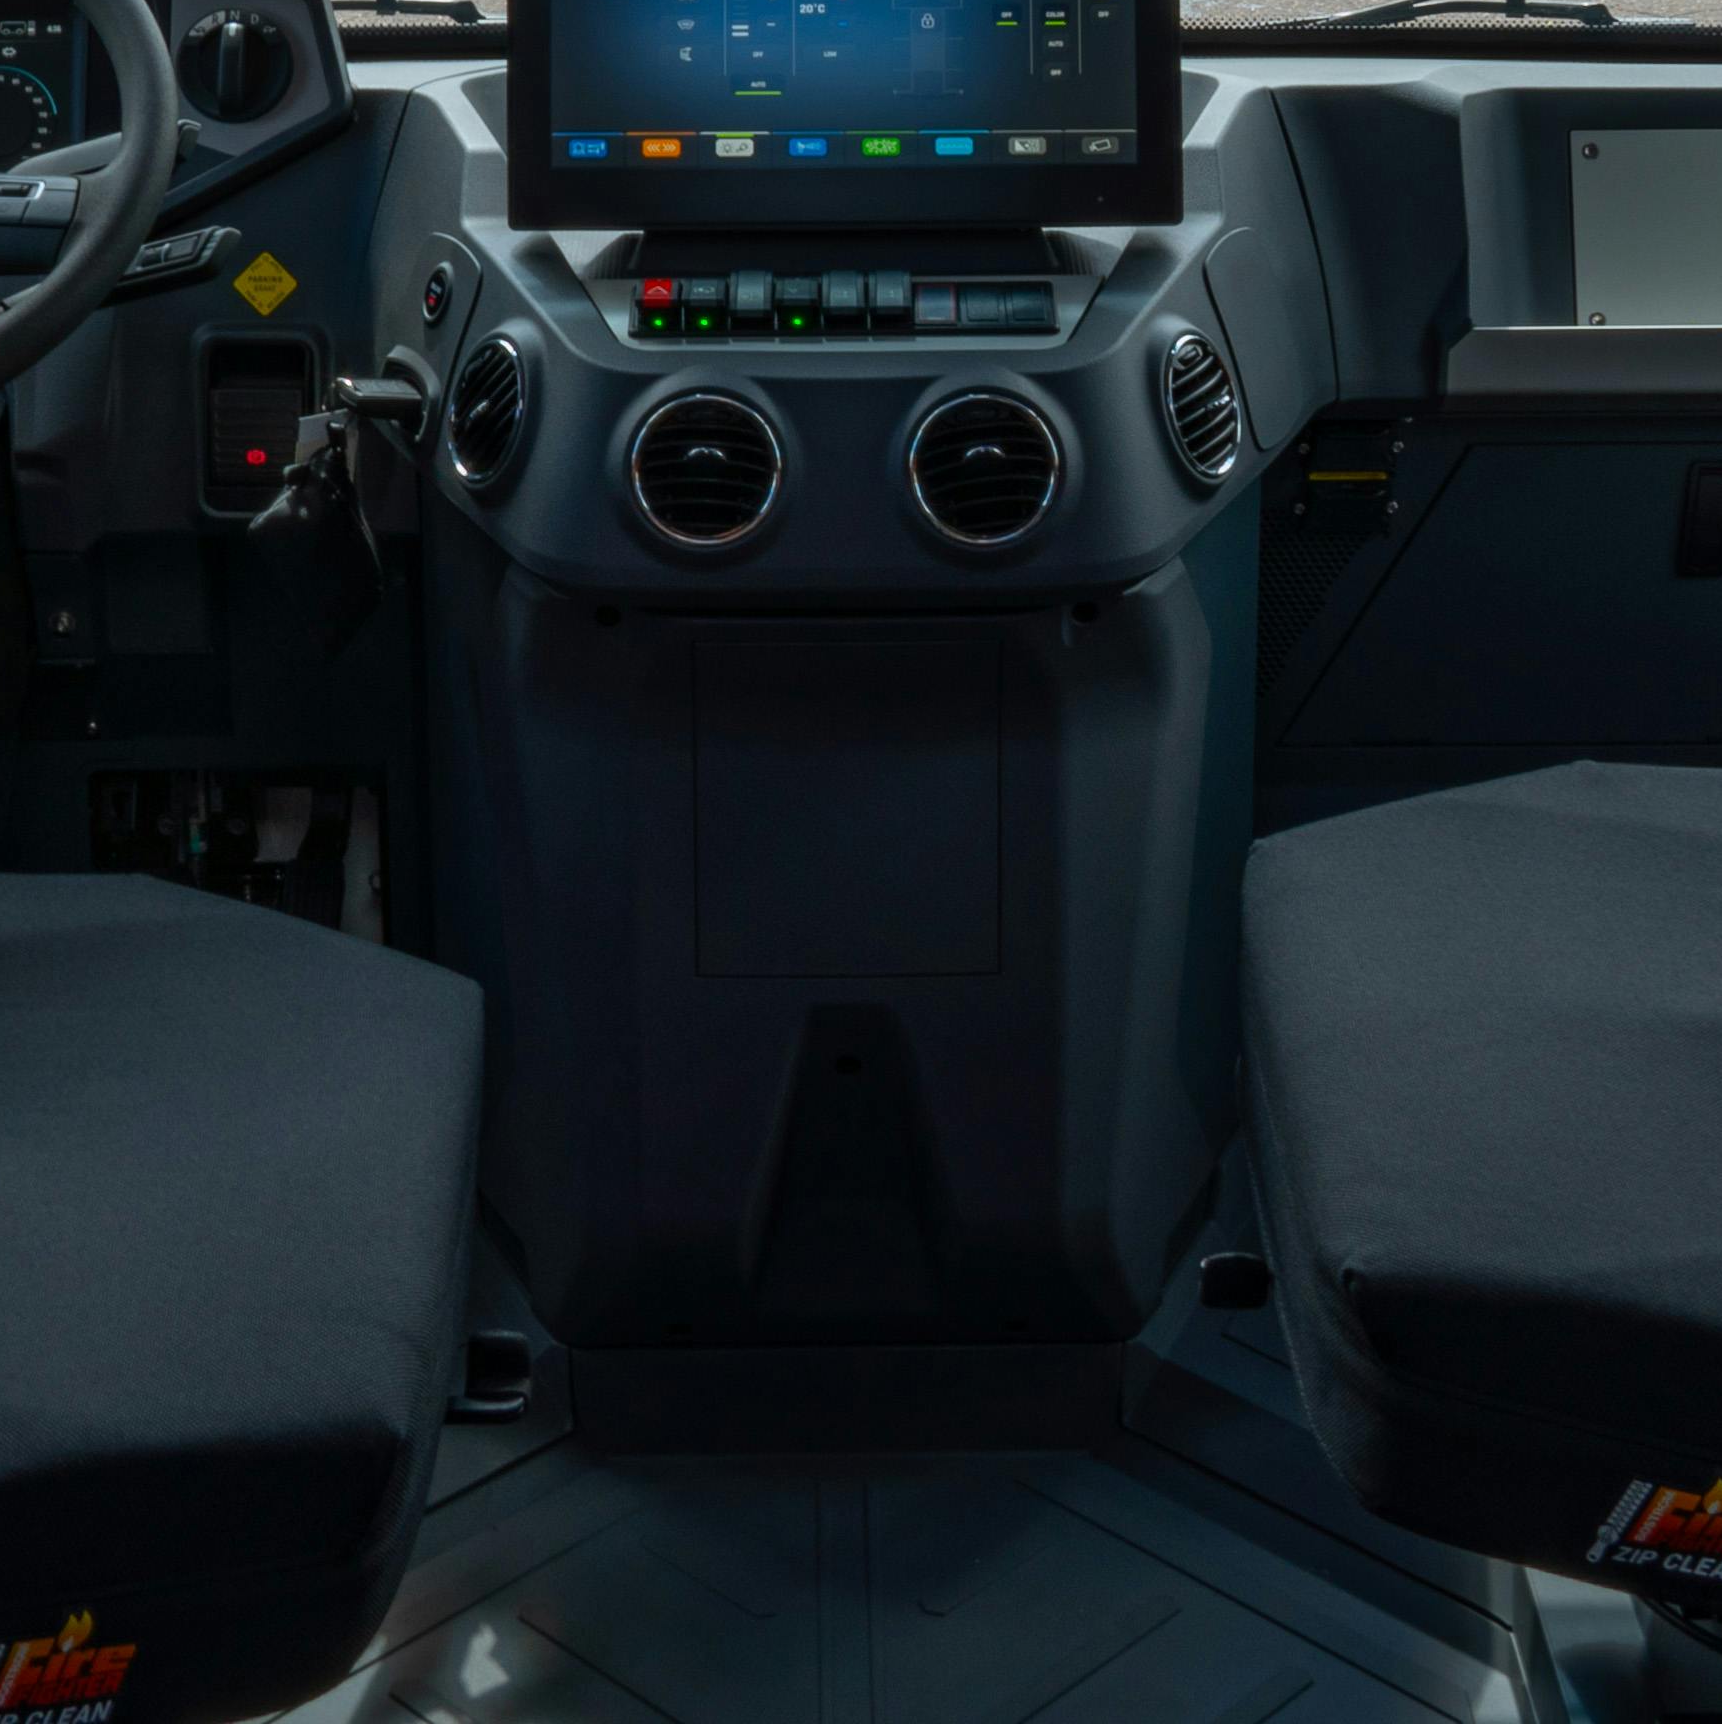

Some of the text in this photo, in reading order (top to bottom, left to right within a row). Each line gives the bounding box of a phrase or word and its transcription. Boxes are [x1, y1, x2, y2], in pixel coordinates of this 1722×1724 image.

[229, 10, 241, 21] N
[250, 14, 259, 25] D
[1611, 1545, 1658, 1565] ZIP
[24, 1699, 116, 1724] CLEAN
